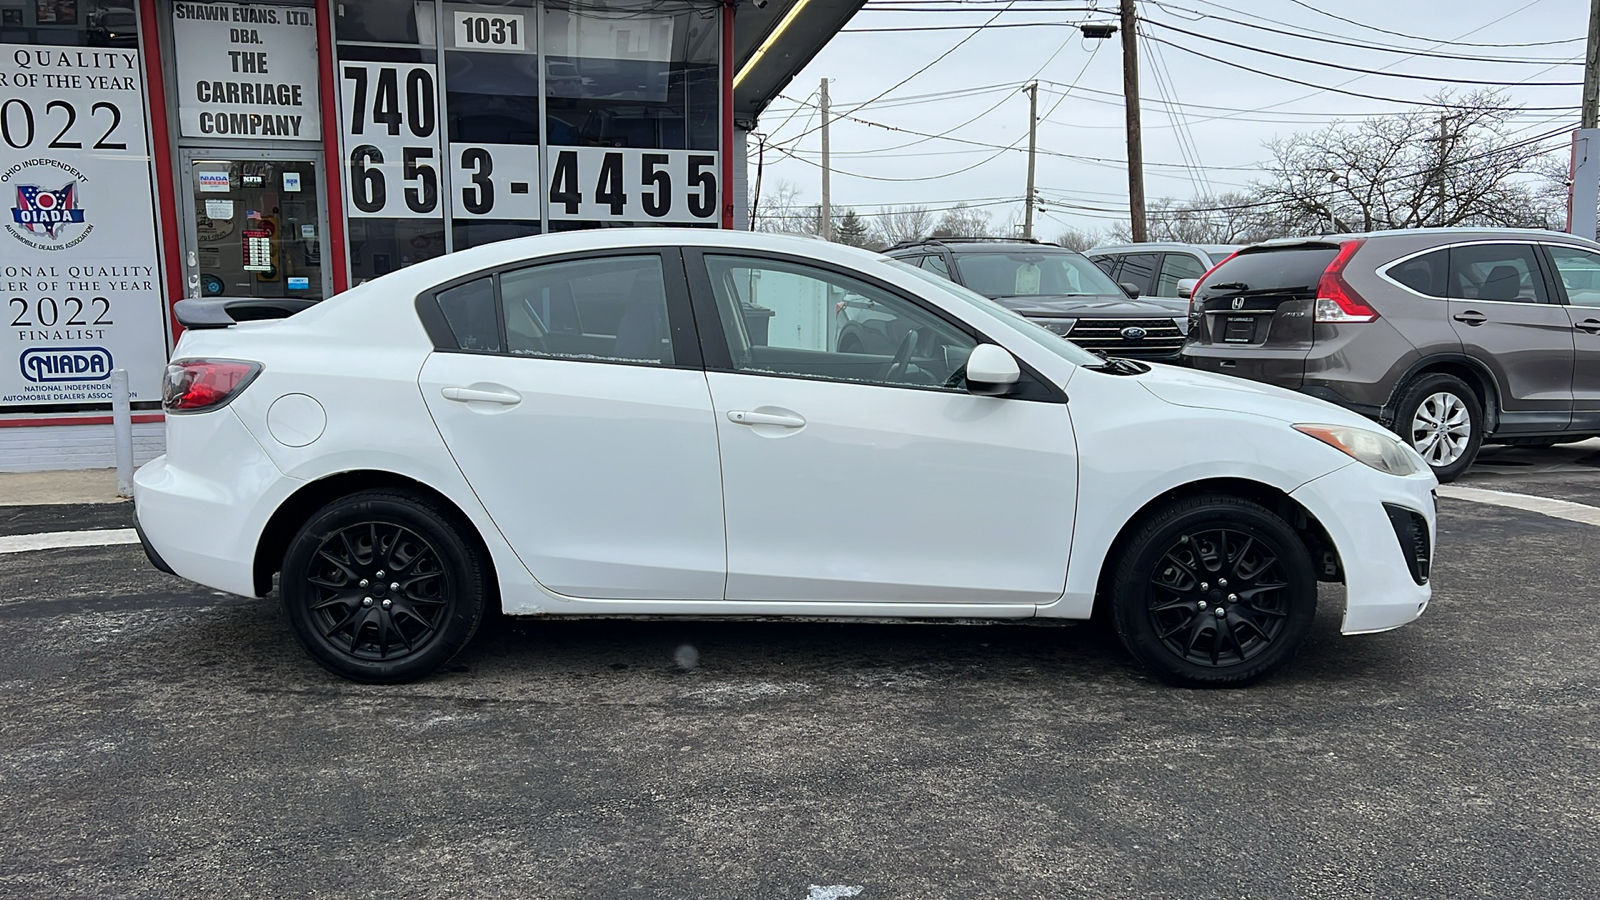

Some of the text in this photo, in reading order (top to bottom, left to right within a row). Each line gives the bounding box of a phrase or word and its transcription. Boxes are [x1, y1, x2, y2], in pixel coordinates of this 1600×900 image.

[175, 3, 313, 27] SHAWN EVANS. LTD.
[229, 28, 263, 44] DBA.
[462, 16, 518, 45] 1031
[14, 49, 136, 69] QUALITY
[227, 51, 269, 74] THE
[13, 72, 38, 88] OF
[43, 74, 82, 89] THE
[86, 75, 136, 91] YEAR
[196, 80, 303, 106] CARRIAGE
[344, 67, 435, 138] 740
[199, 111, 302, 136] COMPANY
[0, 158, 89, 184] OHIO INDEPENDENT
[20, 210, 73, 222] OIADA
[4, 224, 37, 249] AUTOMOBILE
[65, 223, 94, 249] ASSOCIATION
[68, 266, 153, 279] QUALITY
[37, 281, 59, 291] OF
[66, 281, 101, 291] THE
[108, 280, 153, 291] YEAR
[9, 296, 114, 326] 2022
[18, 329, 105, 341] FINALIST
[27, 353, 105, 375] NIADA
[2, 394, 52, 402] AUTOMOBILE
[24, 383, 112, 392] NATIONAL INDEPENDEN
